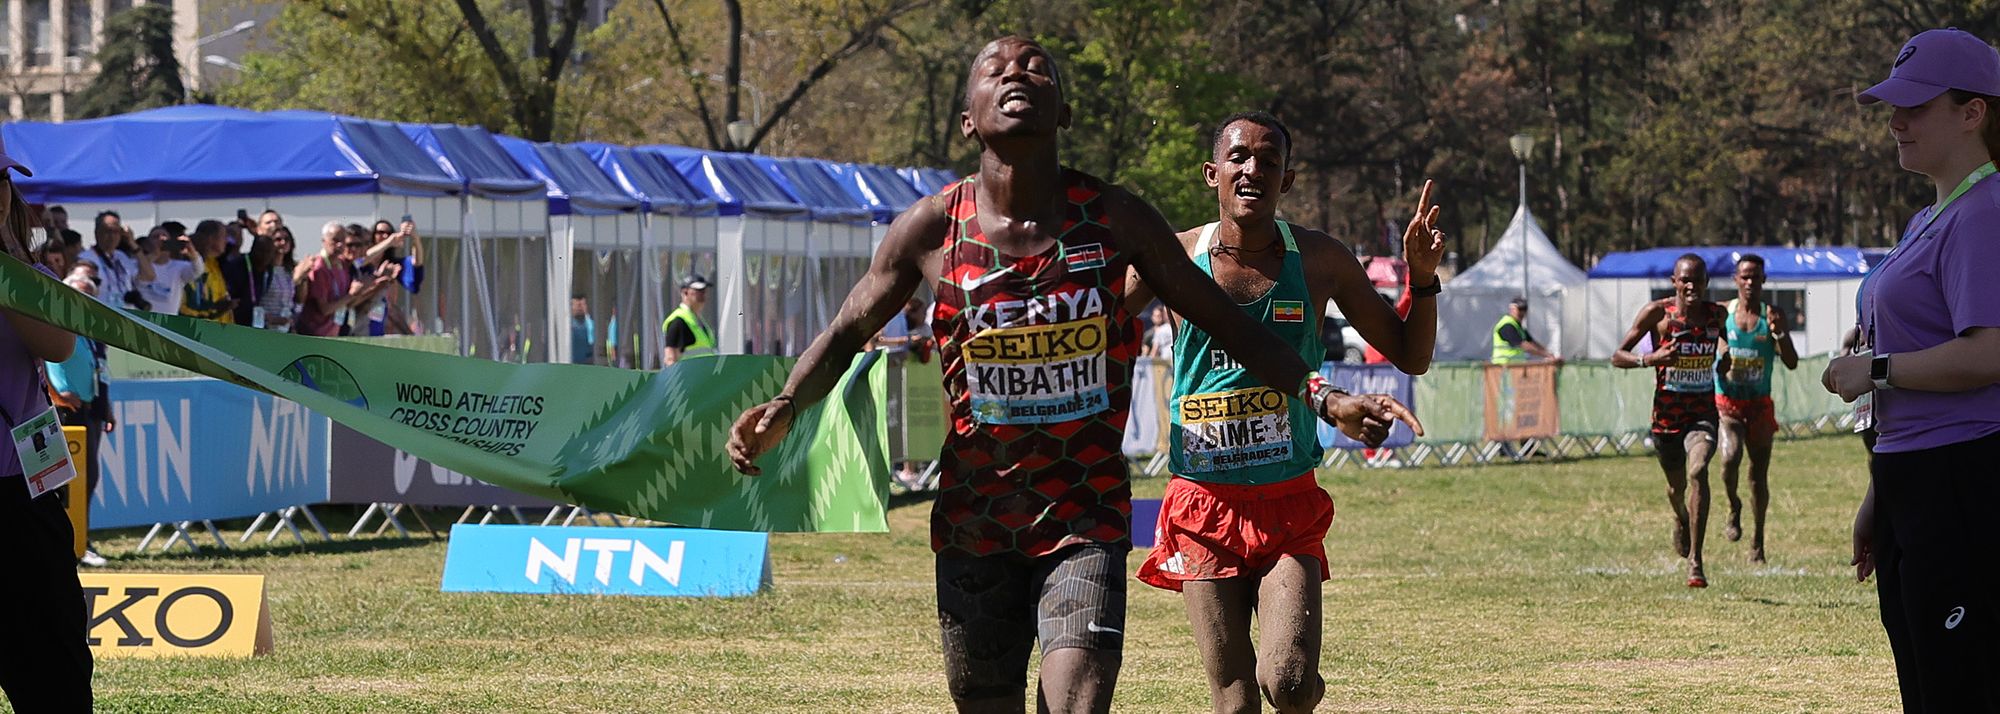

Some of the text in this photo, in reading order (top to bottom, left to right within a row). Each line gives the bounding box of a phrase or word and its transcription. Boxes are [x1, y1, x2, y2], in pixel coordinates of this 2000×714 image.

[965, 287, 1103, 332] KENYA
[968, 324, 1101, 360] SEIKO
[977, 356, 1099, 396] KIBATHI
[395, 382, 545, 416] WORLD ATHLETICS
[1010, 394, 1102, 417] BELGRADE 24
[1183, 389, 1283, 421] SEIKO
[390, 407, 538, 440] CROSS COUNTRY
[1205, 420, 1266, 449] SIME
[95, 395, 310, 508] NTN NTN
[1213, 446, 1289, 465] BELGRADE 24
[525, 536, 685, 588] NTN
